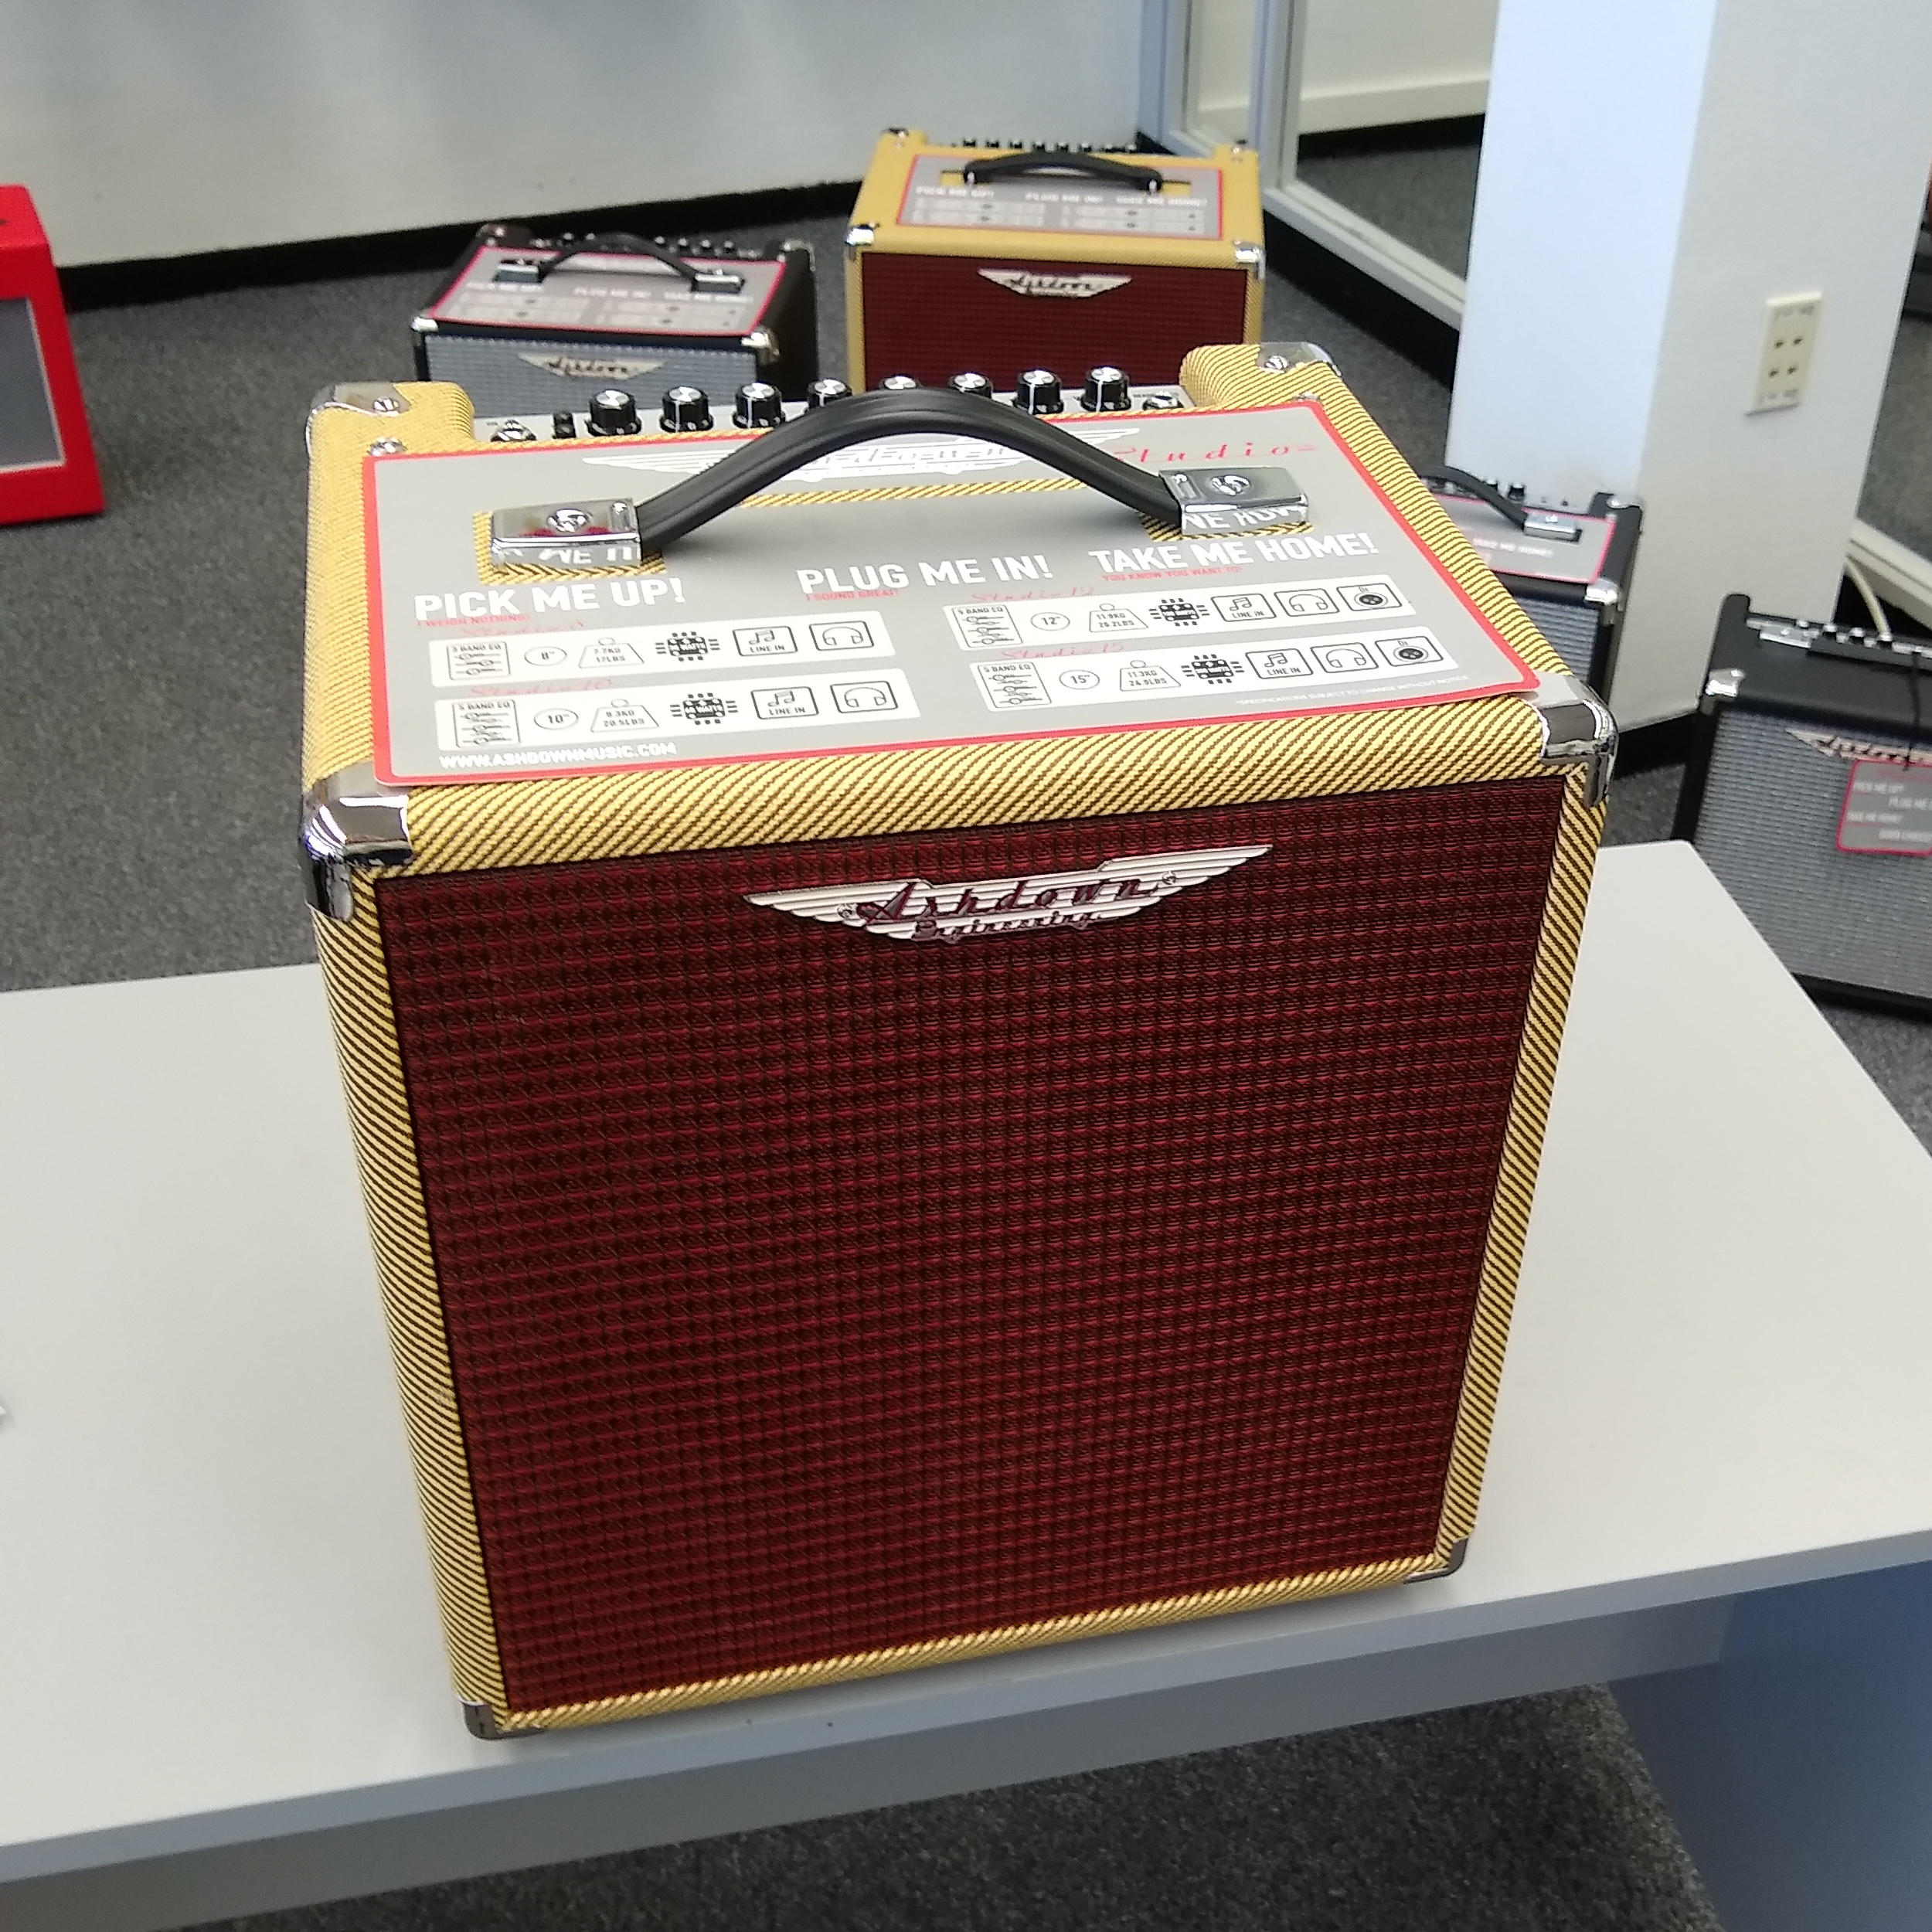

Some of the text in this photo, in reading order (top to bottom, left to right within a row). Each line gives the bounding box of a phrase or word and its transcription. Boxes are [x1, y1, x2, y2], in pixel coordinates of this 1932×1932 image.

[1088, 532, 1379, 573] TAKE ME HOME!
[796, 555, 1054, 595] PLUG ME IN!
[1102, 573, 1126, 582] YOU
[1165, 570, 1189, 578] YOU
[414, 577, 686, 621] PICK ME UP!
[1231, 611, 1253, 620] LINE
[750, 644, 785, 653] LINE IN
[1267, 668, 1287, 676] LINE
[769, 707, 792, 716] LINE
[439, 742, 677, 769] WWW.ASHDOWNMUSIC.COM
[857, 879, 1159, 923] Ashdown
